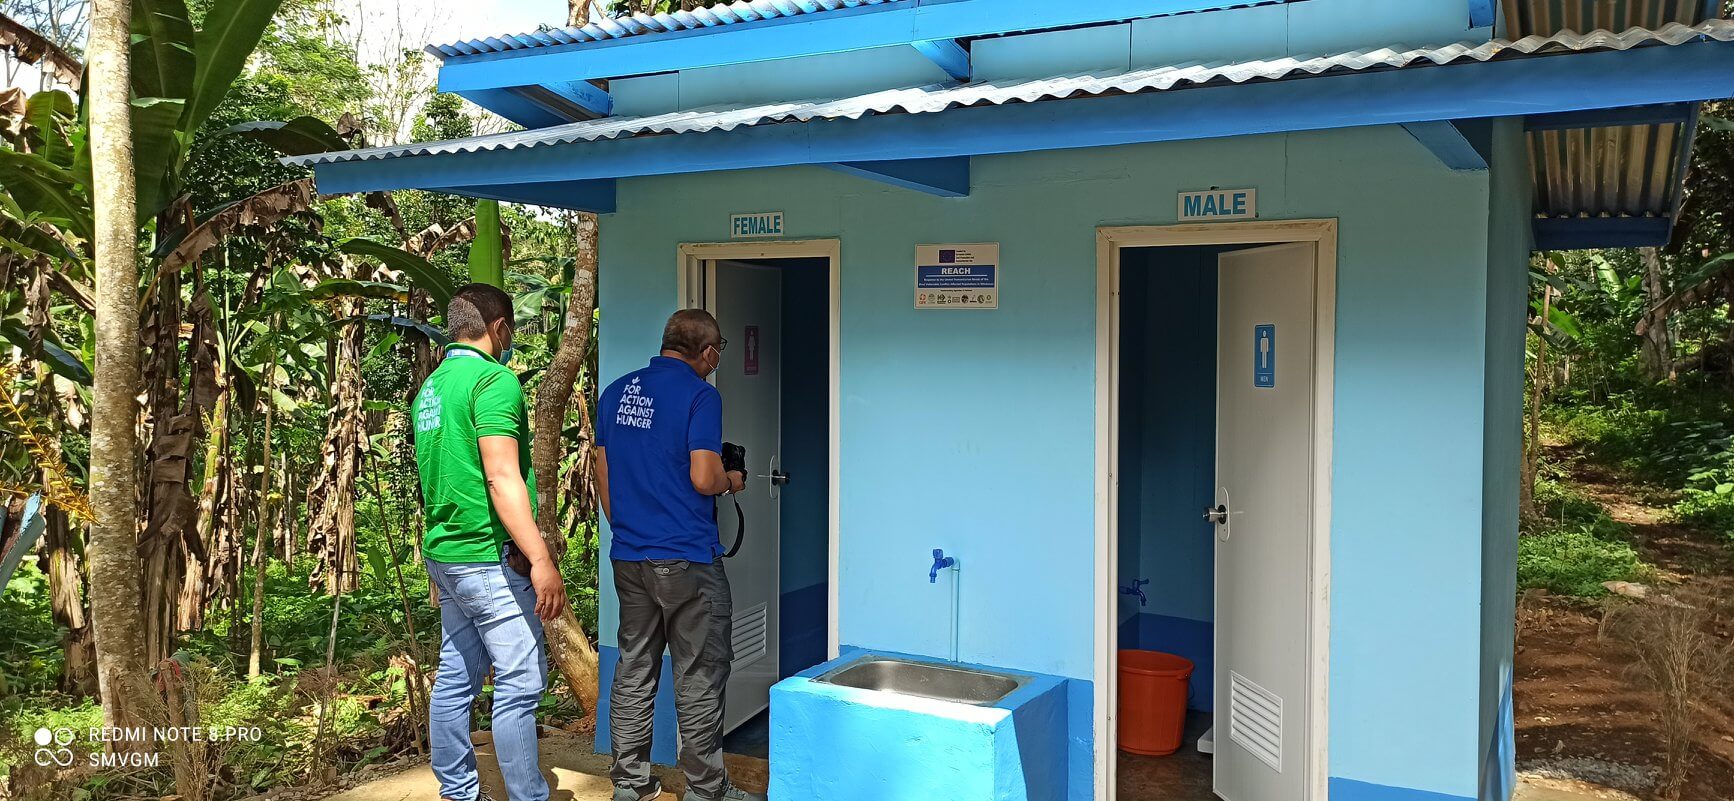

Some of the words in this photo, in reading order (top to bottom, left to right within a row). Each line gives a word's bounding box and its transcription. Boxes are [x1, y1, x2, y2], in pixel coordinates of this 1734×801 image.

[1184, 193, 1246, 217] MALE
[734, 215, 781, 235] FEMALE
[941, 267, 971, 275] REACH
[623, 384, 642, 395] FOR
[619, 394, 654, 407] ACTION
[617, 403, 655, 419] AGAINST
[616, 414, 652, 429] HUNGER
